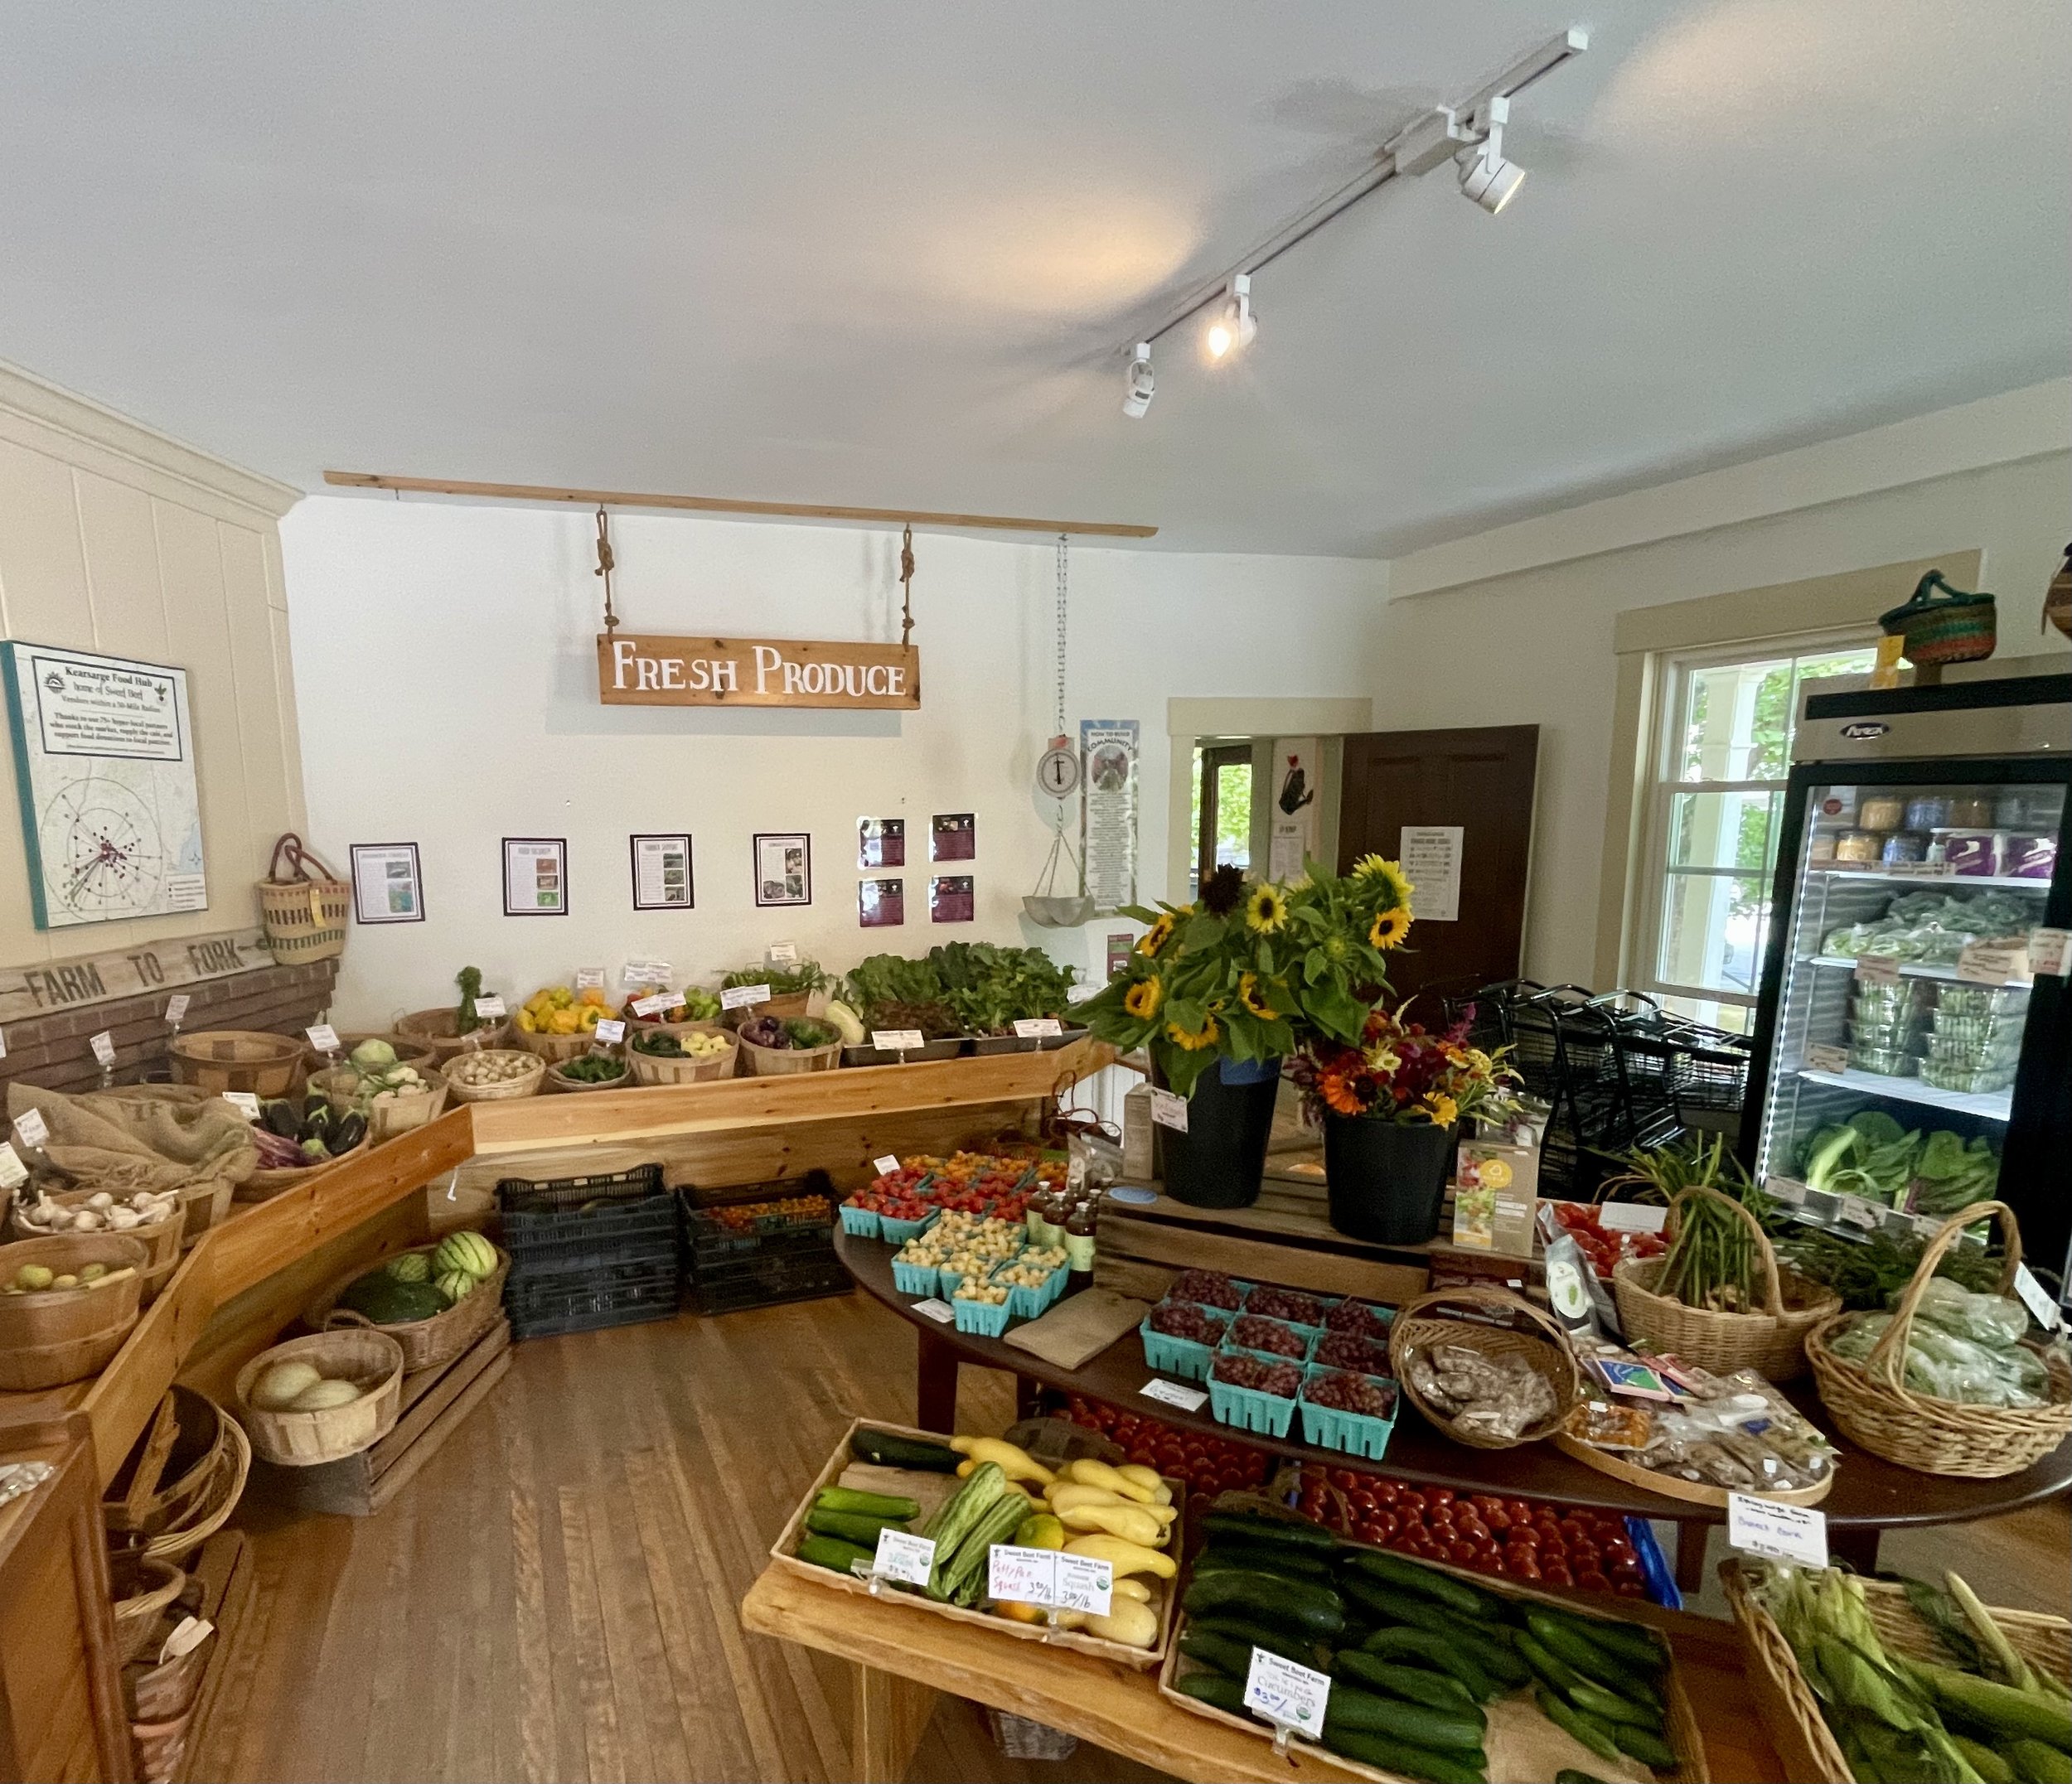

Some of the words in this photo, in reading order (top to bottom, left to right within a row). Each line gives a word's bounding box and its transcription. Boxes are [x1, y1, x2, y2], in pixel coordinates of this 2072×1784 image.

[65, 666, 110, 683] Kearsarge
[112, 673, 133, 684] Food
[135, 676, 152, 687] Hub
[612, 641, 739, 692] FRESH
[752, 645, 907, 697] PRODUCE
[73, 681, 93, 693] home
[95, 682, 103, 695] of
[1087, 737, 1133, 752] COMMUNITY
[23, 961, 107, 1008] FARM
[127, 952, 165, 988] TO
[186, 938, 246, 976] FORK
